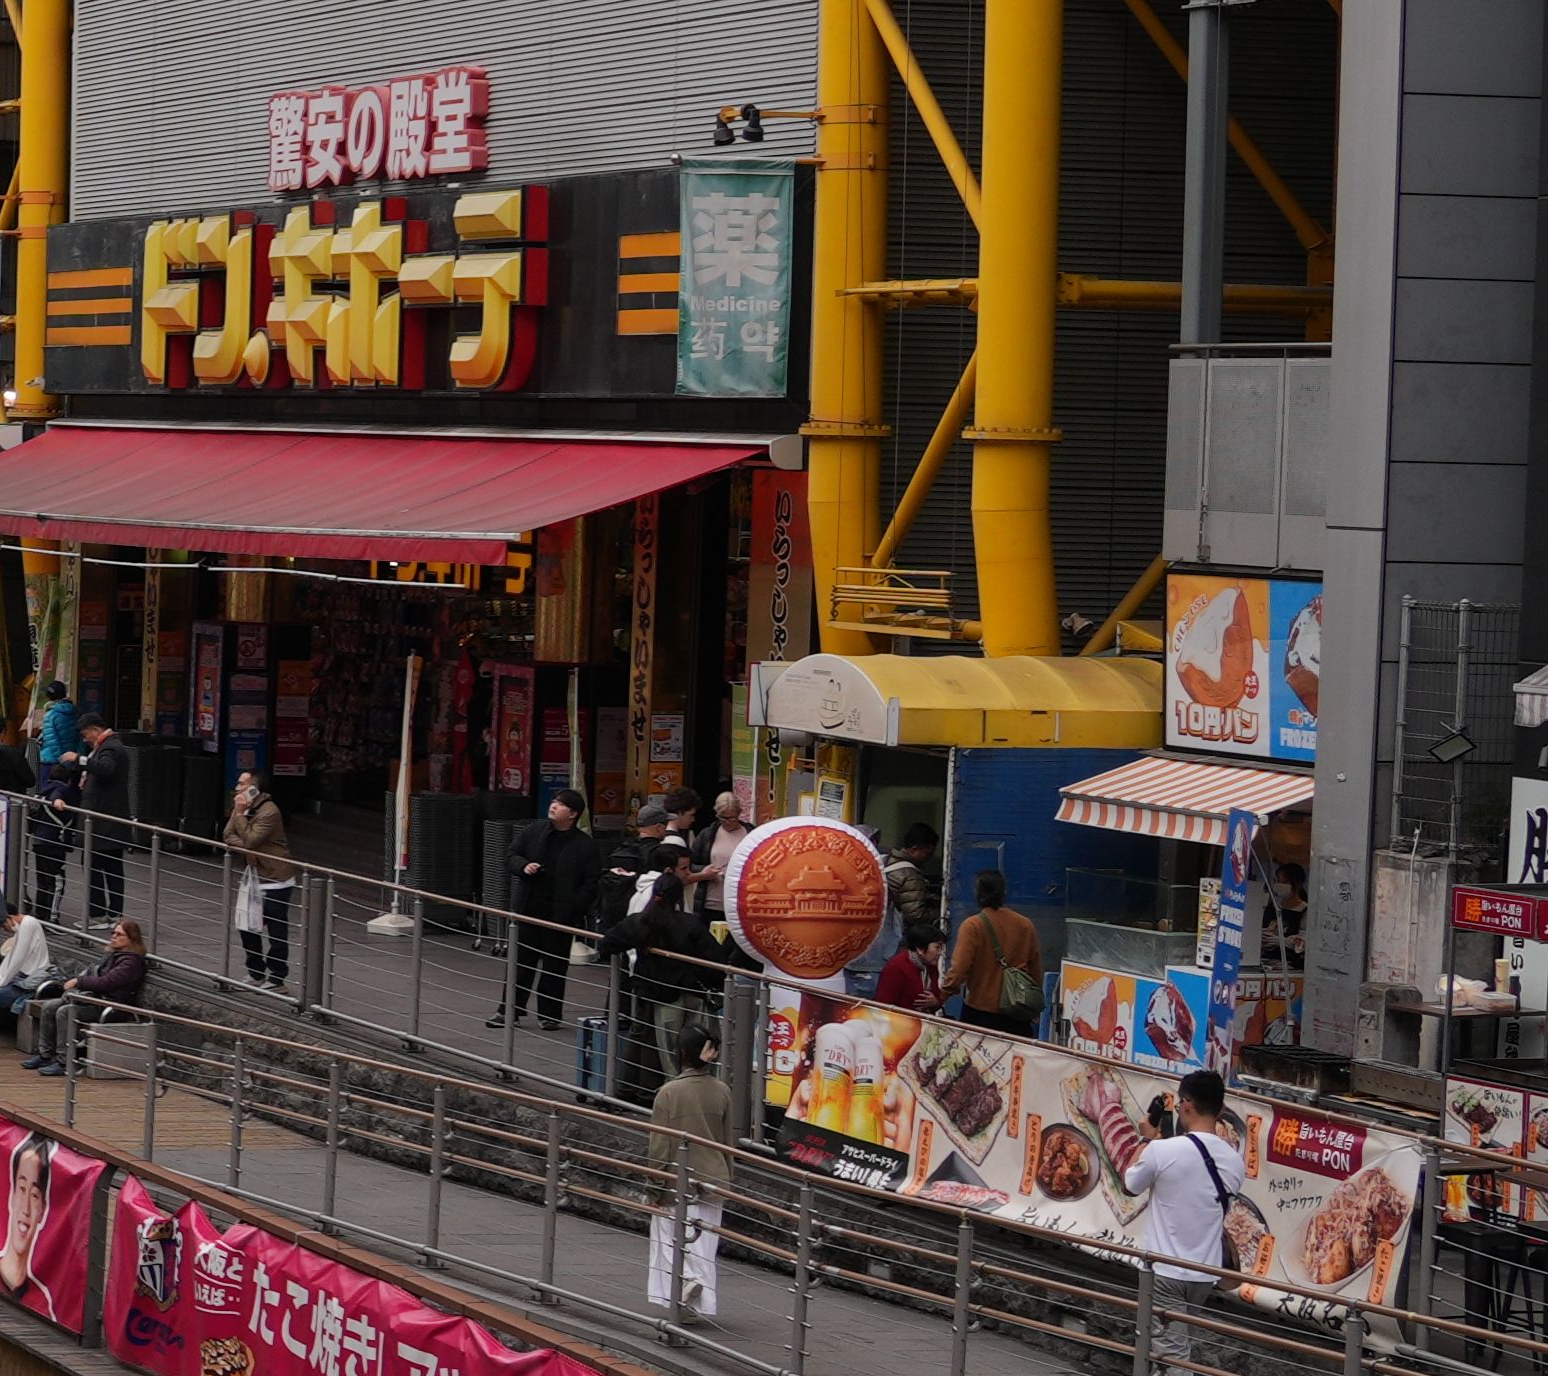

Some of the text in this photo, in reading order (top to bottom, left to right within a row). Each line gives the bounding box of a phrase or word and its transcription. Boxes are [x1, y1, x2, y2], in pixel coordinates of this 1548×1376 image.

[269, 69, 476, 191] 驚安の殿堂
[691, 191, 780, 288] 薬
[689, 294, 782, 316] Medicine
[738, 324, 776, 364] 약
[767, 489, 793, 804] いらっしゃせ!
[1175, 699, 1259, 744] 10円パン
[1501, 915, 1523, 929] PON
[1321, 1149, 1351, 1173] PON
